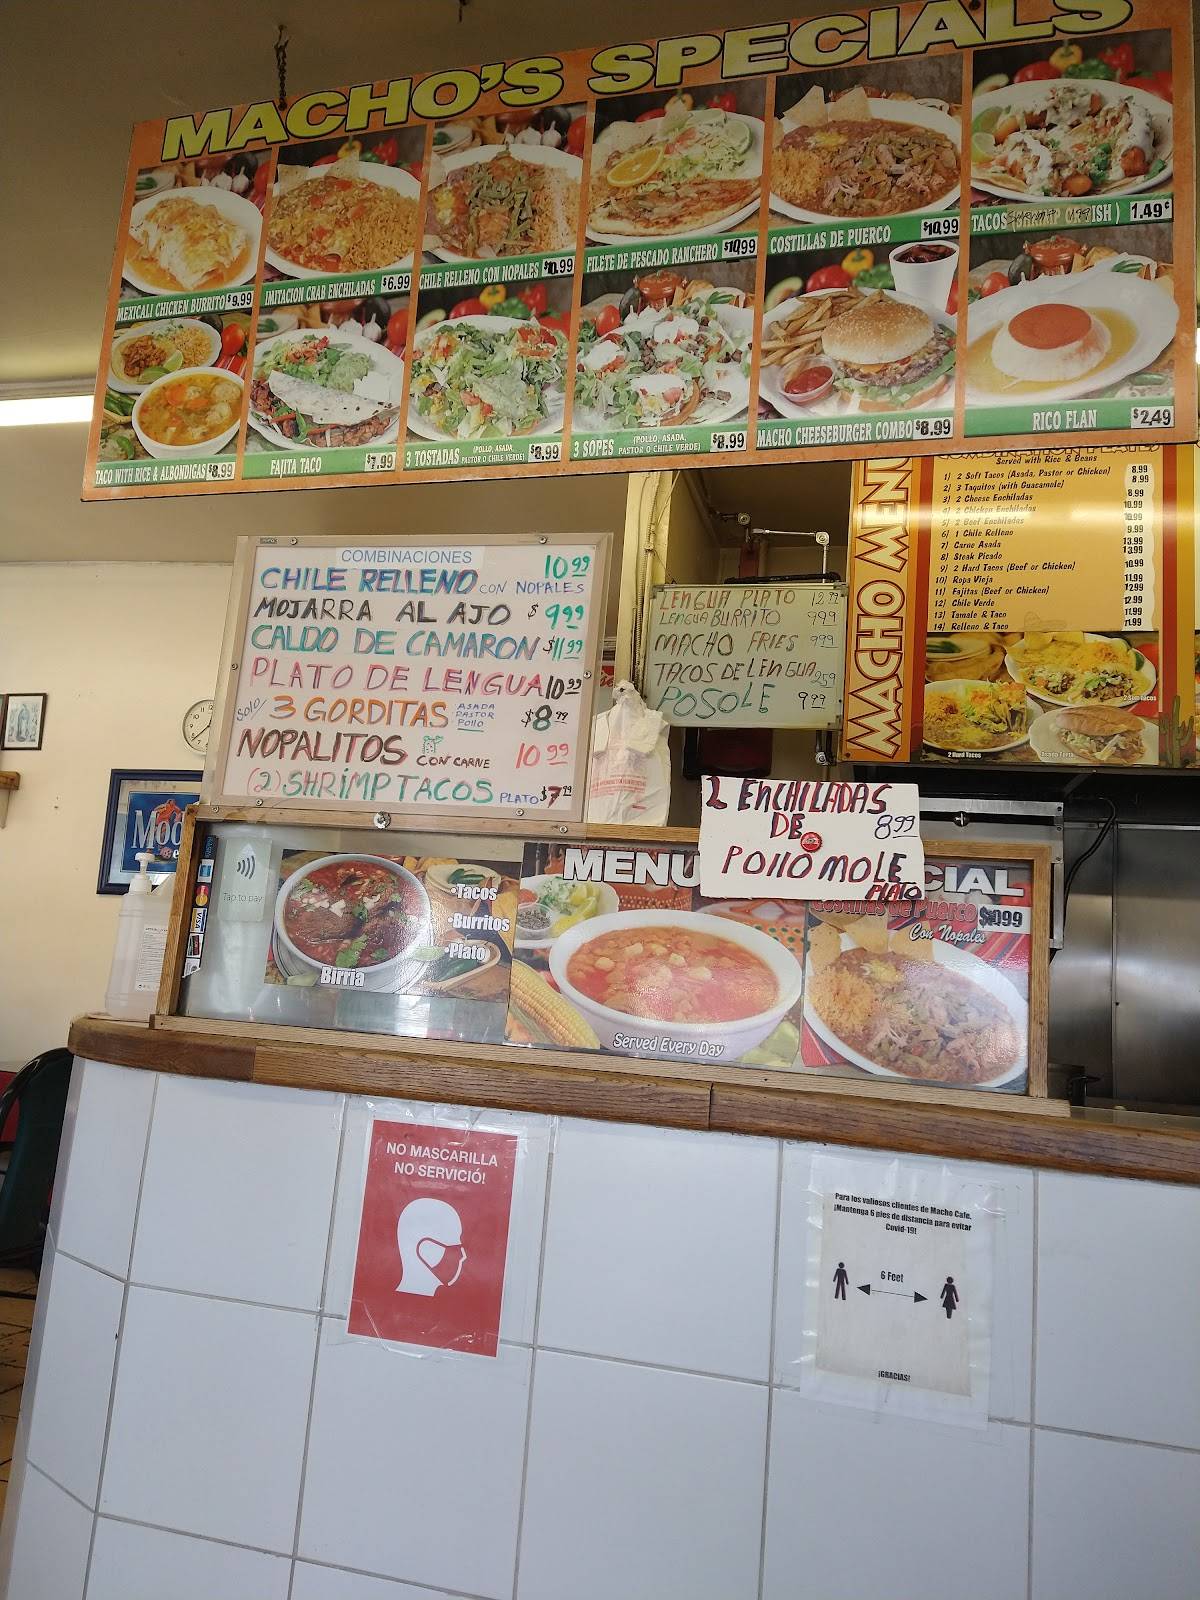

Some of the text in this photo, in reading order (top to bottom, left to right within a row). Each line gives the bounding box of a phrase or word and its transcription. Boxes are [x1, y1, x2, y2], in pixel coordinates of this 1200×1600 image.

[161, 0, 1134, 162] MACHO'S SPECIALS
[971, 212, 1007, 231] TACOS
[770, 226, 891, 253] COSTILLAS DE PUERCO
[587, 243, 718, 272] FILETE DE PESCADO RANCHERO
[382, 276, 410, 290] $6.99
[419, 262, 539, 289] CHILE RELLENO CON NOPALES
[227, 292, 252, 306] $9.99
[265, 280, 375, 306] IMITACION CRAB ENCHILADAS
[116, 295, 225, 320] MEXICALI CHICKEN BURRITO
[915, 419, 951, 436] $8.99
[1032, 409, 1097, 431] RICO FLAN
[757, 419, 913, 448] MACHO CHEESEBURGER COMBO
[406, 448, 460, 467] 3 TOSTADAS
[574, 439, 615, 458] 3 SOPES
[619, 446, 643, 455] PASTOR
[653, 444, 672, 453] CHILE
[1025, 455, 1042, 465] with
[1074, 454, 1097, 463] Beans
[95, 463, 206, 485] TACO WITH RICE & ALBONDIGAS
[270, 457, 322, 478] FAJITA TACO
[984, 471, 1005, 479] Tacos
[1132, 465, 1148, 473] 8.99
[340, 549, 473, 565] COMBINACIONES
[983, 563, 1003, 571] Tacos
[260, 567, 585, 595] CHILE RELLENO CON NOPALES
[253, 599, 511, 625] MOJARRA AL AJO
[974, 599, 995, 607] Verde
[711, 608, 781, 627] BURRITO
[251, 624, 539, 660] CALDO DE CAMARON
[655, 631, 798, 657] MACHO FRIES
[249, 656, 543, 697] PLATO DE LENGUA
[654, 662, 719, 686] TACOS
[721, 663, 744, 681] DE
[848, 580, 905, 759] MACHO
[269, 695, 449, 728] 3 GORDITAS
[457, 702, 495, 711] ASADA
[655, 682, 776, 719] POSOLE
[456, 711, 494, 720] PASTOR
[236, 728, 490, 769] NOPALITOS CON CARNE
[248, 770, 281, 797] (2)
[397, 775, 493, 803] TACOS
[500, 792, 539, 805] PLATO
[706, 777, 727, 809] 2
[770, 812, 805, 840] DE
[563, 848, 700, 888] MENU
[818, 851, 907, 884] MOLE
[456, 883, 498, 901] Tacos
[194, 912, 203, 930] VISA
[452, 912, 510, 932] Burritos
[909, 922, 987, 945] Con Nopales
[449, 942, 486, 961] Plato
[320, 966, 365, 988] Birria
[613, 1032, 724, 1057] Served Every Day
[387, 1142, 498, 1167] NO MASCARILLA
[394, 1162, 486, 1185] NO SERVICIÓ!
[835, 1192, 850, 1202] Para
[851, 1195, 862, 1203] los
[862, 1196, 891, 1208] valiosos
[891, 1200, 919, 1212] clientes
[920, 1204, 929, 1213] de
[930, 1206, 953, 1218] Macho
[876, 1210, 890, 1220] pies
[891, 1212, 900, 1220] de
[901, 1213, 933, 1226] distancia
[934, 1219, 951, 1229] para
[951, 1220, 972, 1231] evitar
[885, 1223, 917, 1235] Covid-19!
[880, 1271, 904, 1283] 6 Feet
